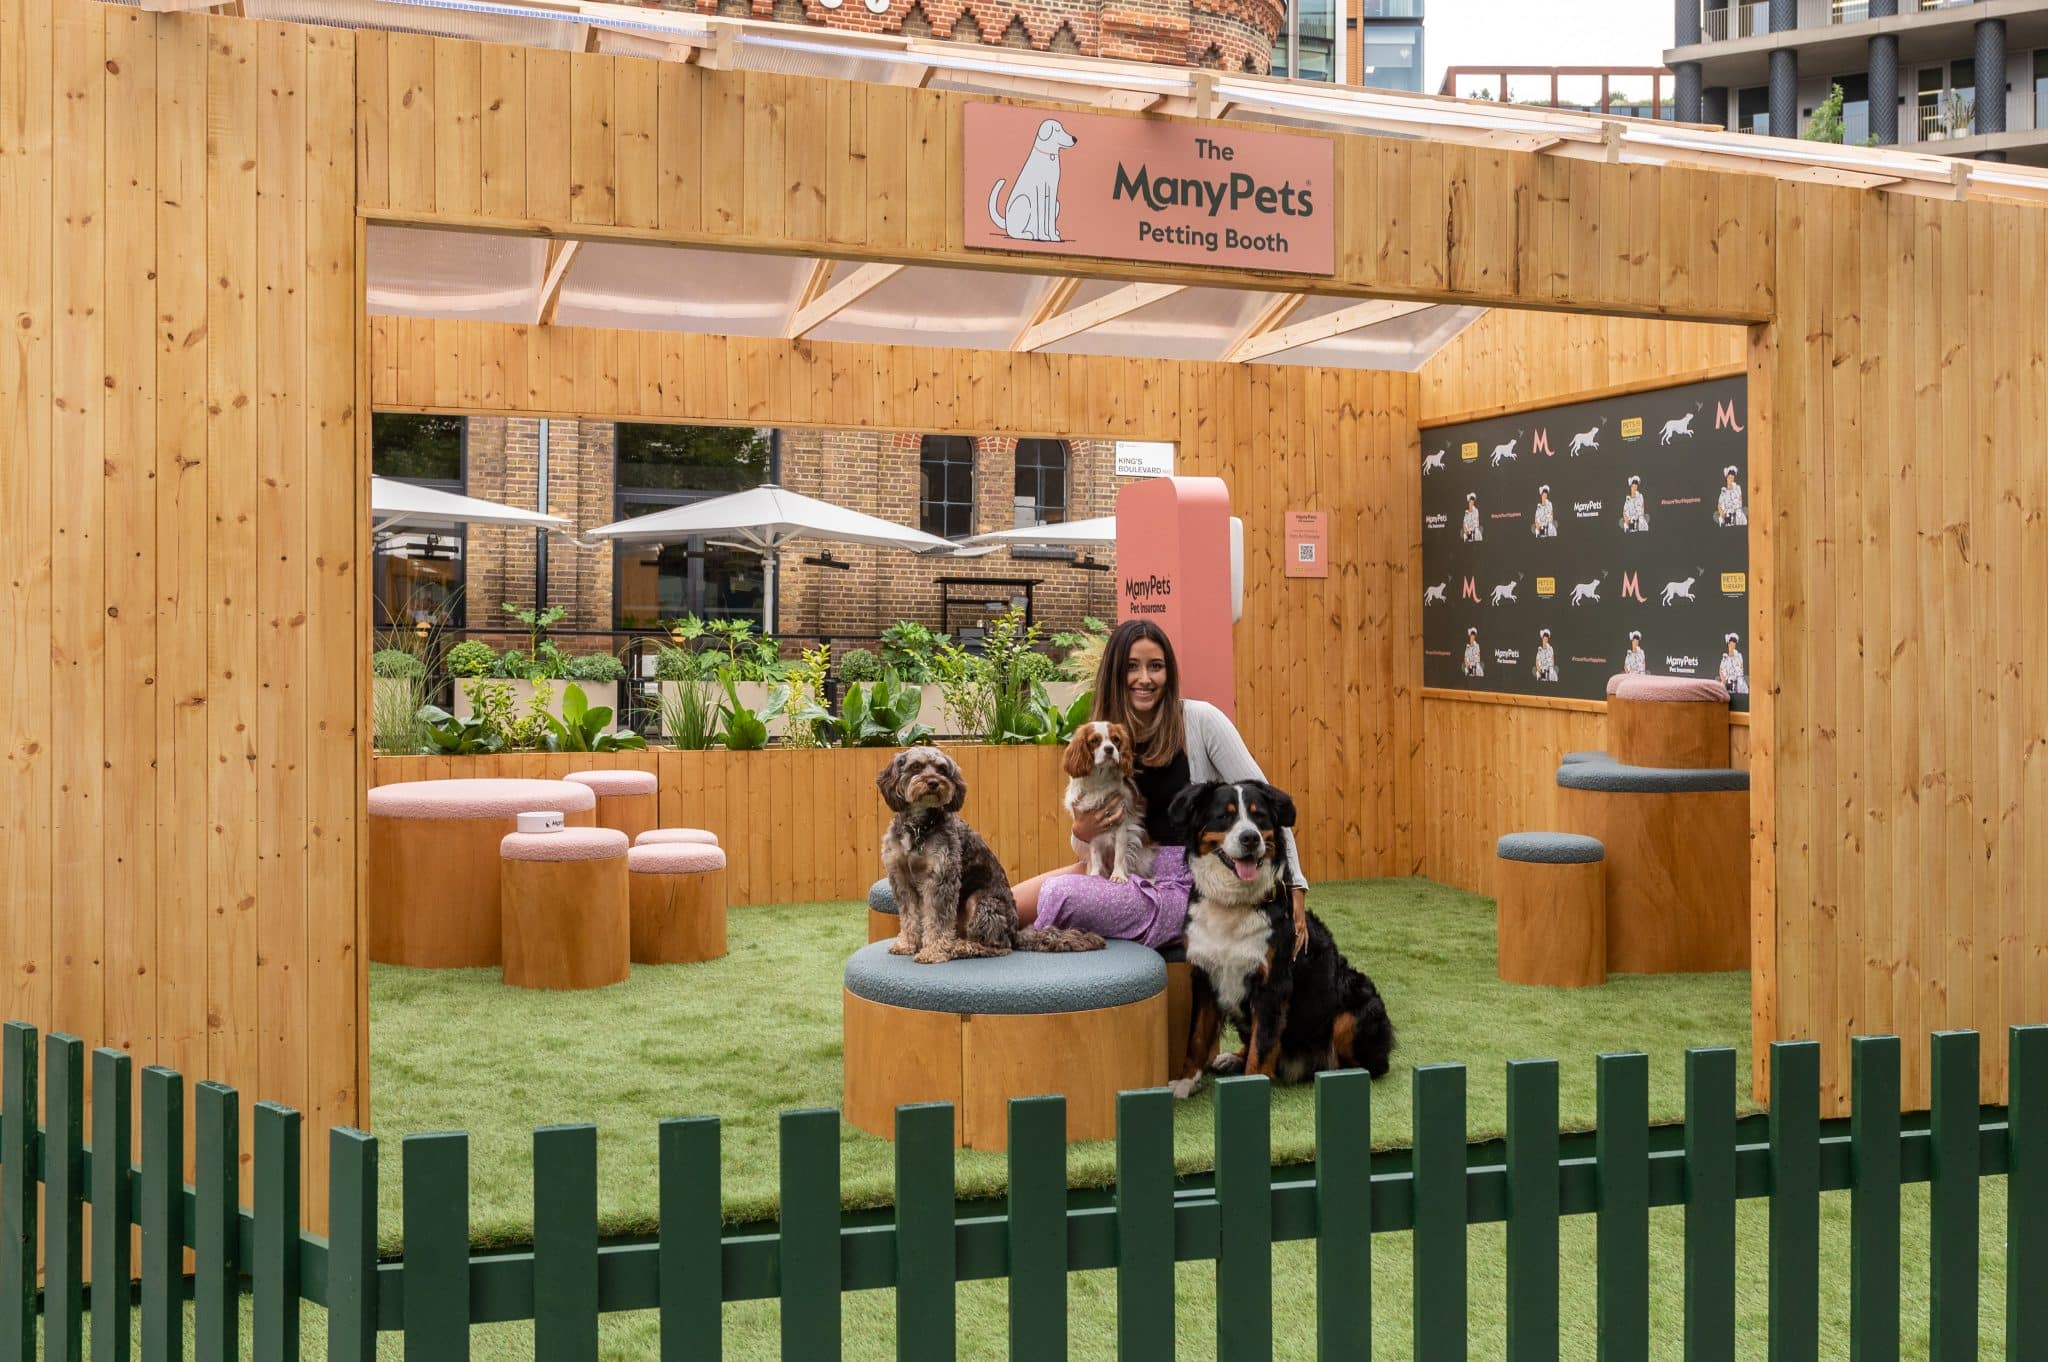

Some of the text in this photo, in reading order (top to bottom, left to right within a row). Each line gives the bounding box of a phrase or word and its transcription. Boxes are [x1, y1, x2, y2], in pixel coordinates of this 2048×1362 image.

[1195, 138, 1234, 161] The
[1139, 221, 1288, 252] Petting Booth
[1118, 457, 1143, 465] KING'S
[1118, 465, 1162, 474] BOULEVARD
[1573, 500, 1602, 512] ManyPets
[1125, 574, 1171, 600] ManyPets
[1130, 602, 1166, 614] Pet Insurance
[1665, 655, 1699, 668] ManyPets
